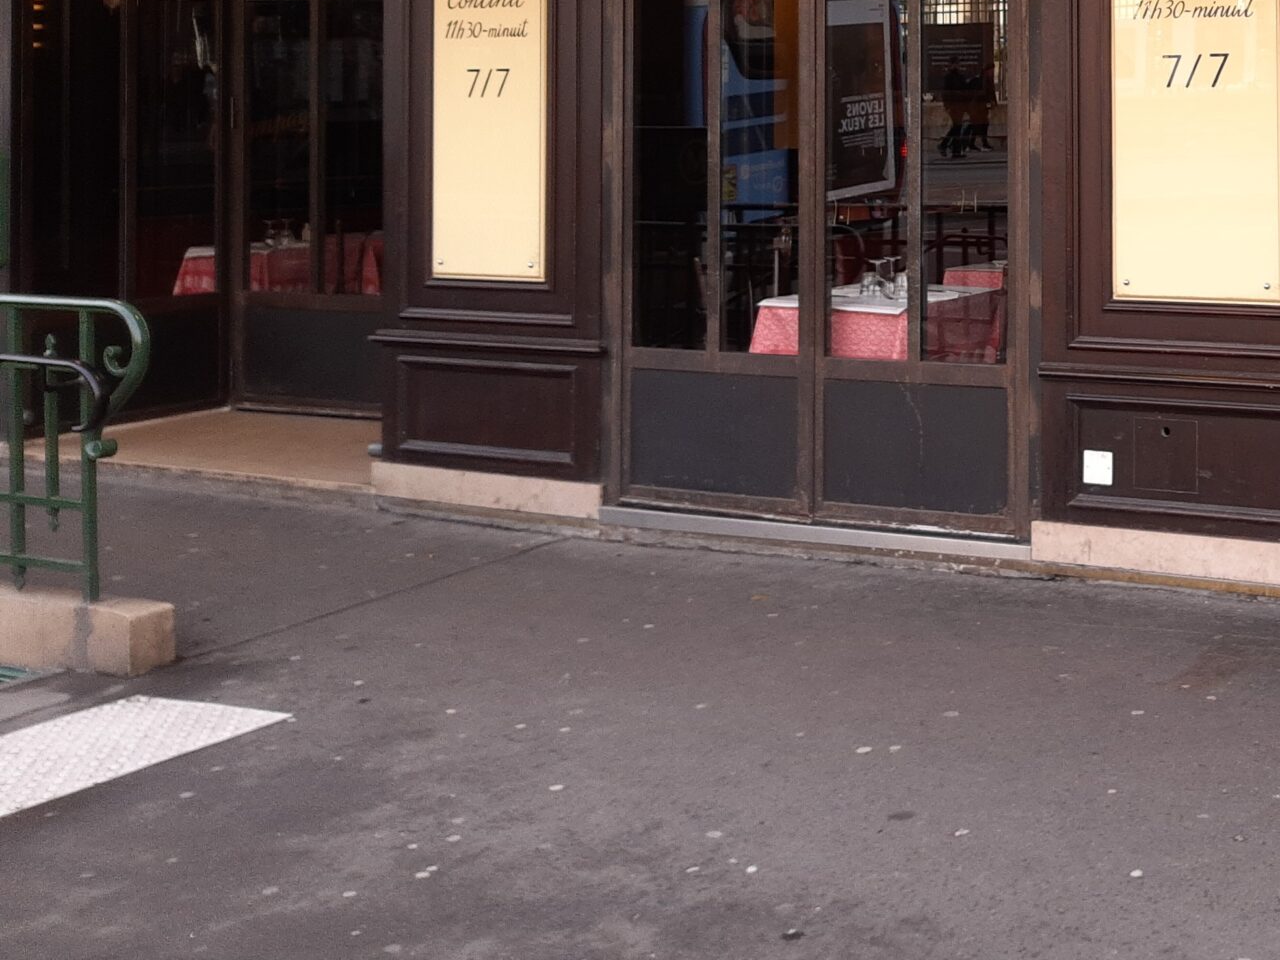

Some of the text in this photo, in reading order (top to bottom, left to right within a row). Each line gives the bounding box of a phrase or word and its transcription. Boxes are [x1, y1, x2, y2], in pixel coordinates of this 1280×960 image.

[445, 18, 528, 39] 11h30-minuit
[466, 68, 510, 98] 7/7
[1162, 53, 1229, 88] 7/7
